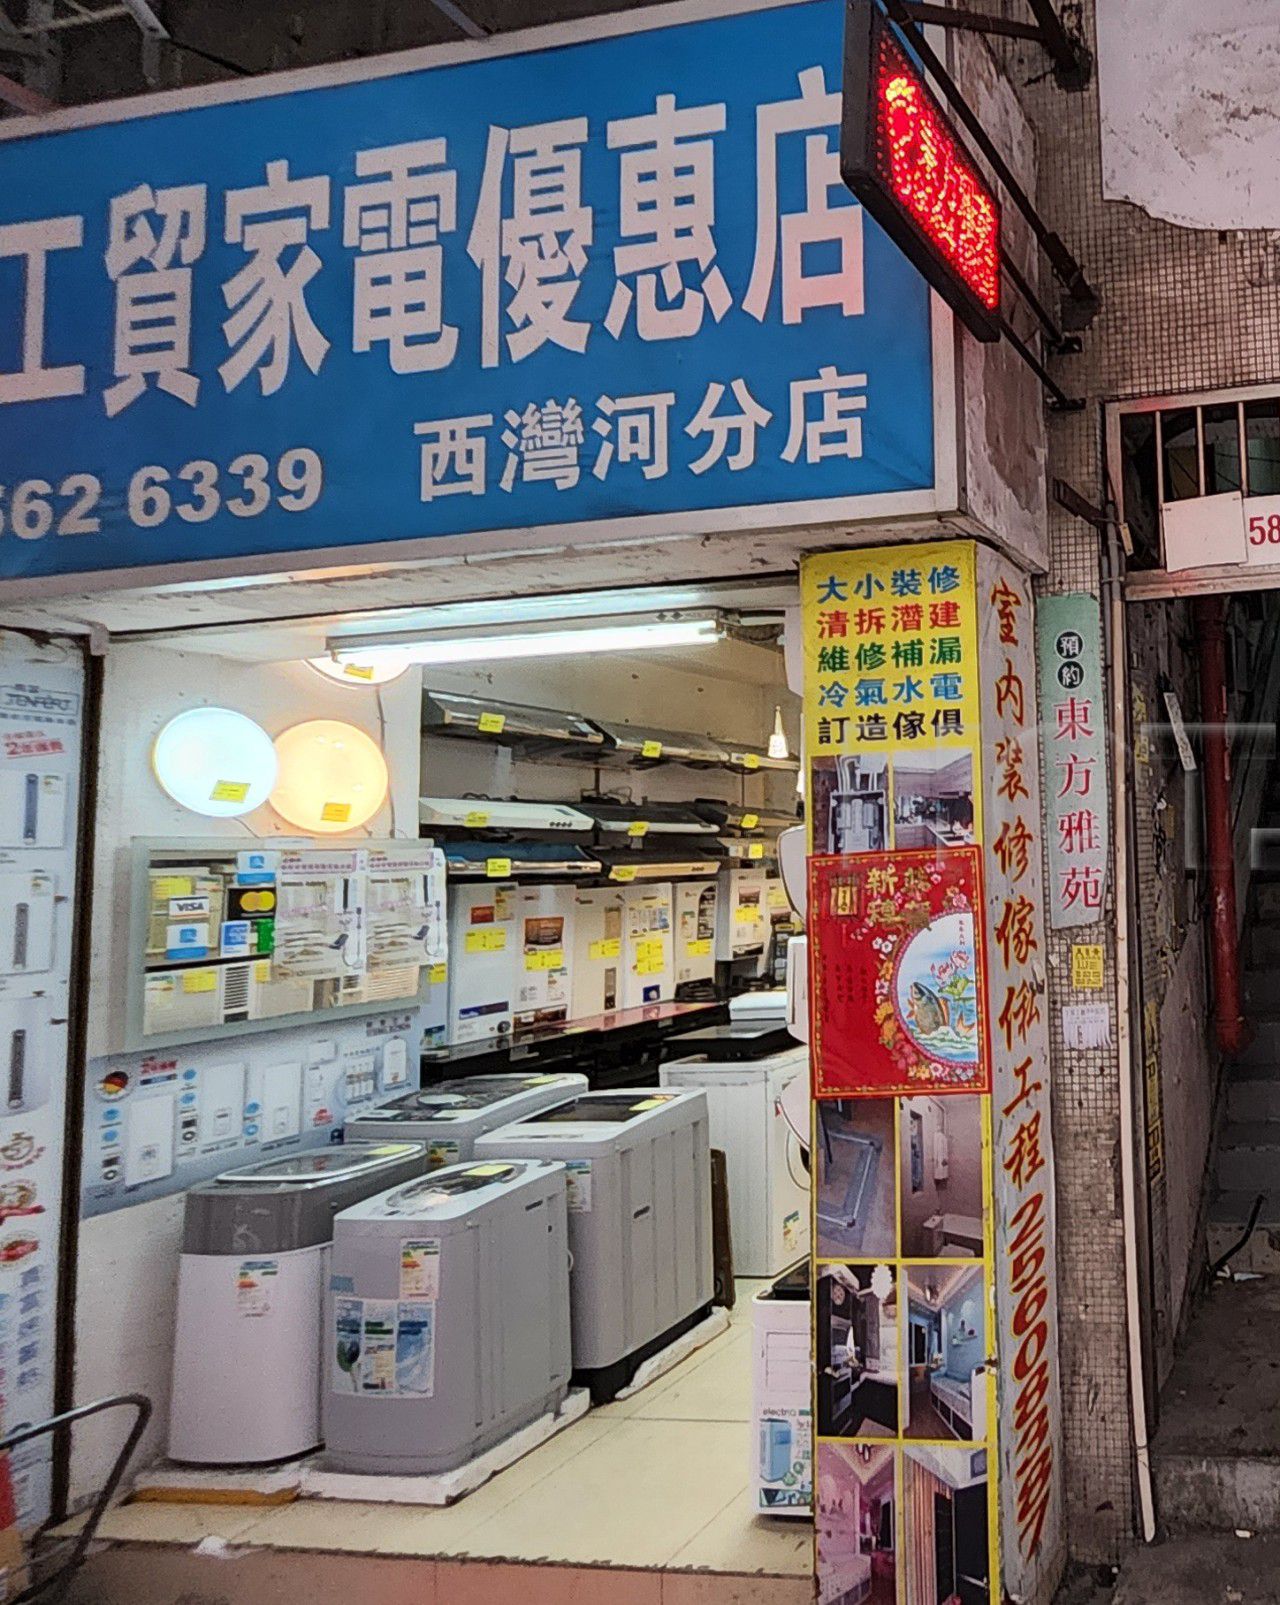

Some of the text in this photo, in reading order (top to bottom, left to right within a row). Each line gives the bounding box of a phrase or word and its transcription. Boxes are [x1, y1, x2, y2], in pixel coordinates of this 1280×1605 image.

[413, 366, 868, 502] 西灣河分店
[0, 448, 323, 540] 62 6339
[816, 565, 960, 604] 大小裝修
[817, 636, 962, 673] 維修補漏
[1058, 633, 1082, 687] 預約
[818, 672, 963, 708] 冷氣水電
[818, 709, 964, 745] 訂造傢俱
[1053, 697, 1102, 911] 東方雅苑
